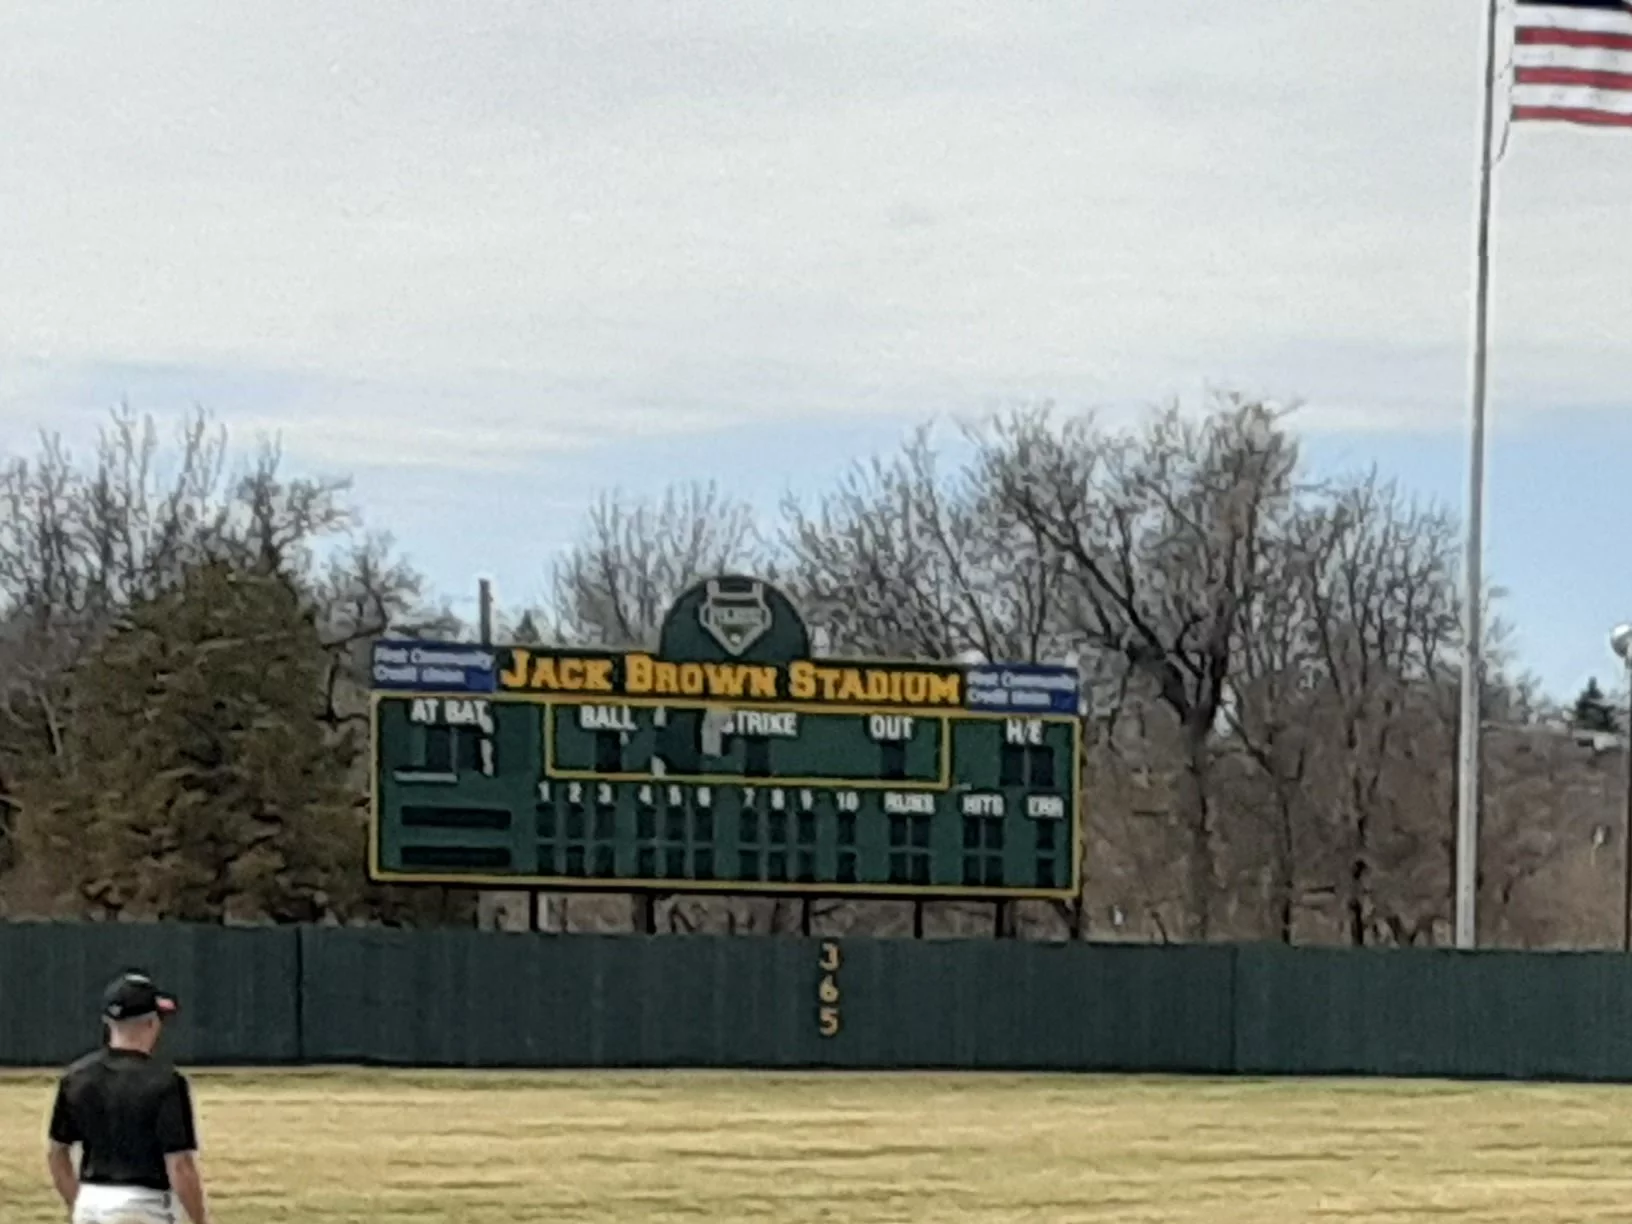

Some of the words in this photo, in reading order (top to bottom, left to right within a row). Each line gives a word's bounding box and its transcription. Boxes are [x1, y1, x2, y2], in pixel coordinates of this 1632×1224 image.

[501, 649, 613, 690] JACK
[625, 652, 777, 697] BROWN
[788, 661, 960, 704] STADIUM
[410, 699, 438, 724] AT
[580, 704, 638, 730] BALL
[869, 714, 914, 740] OUT
